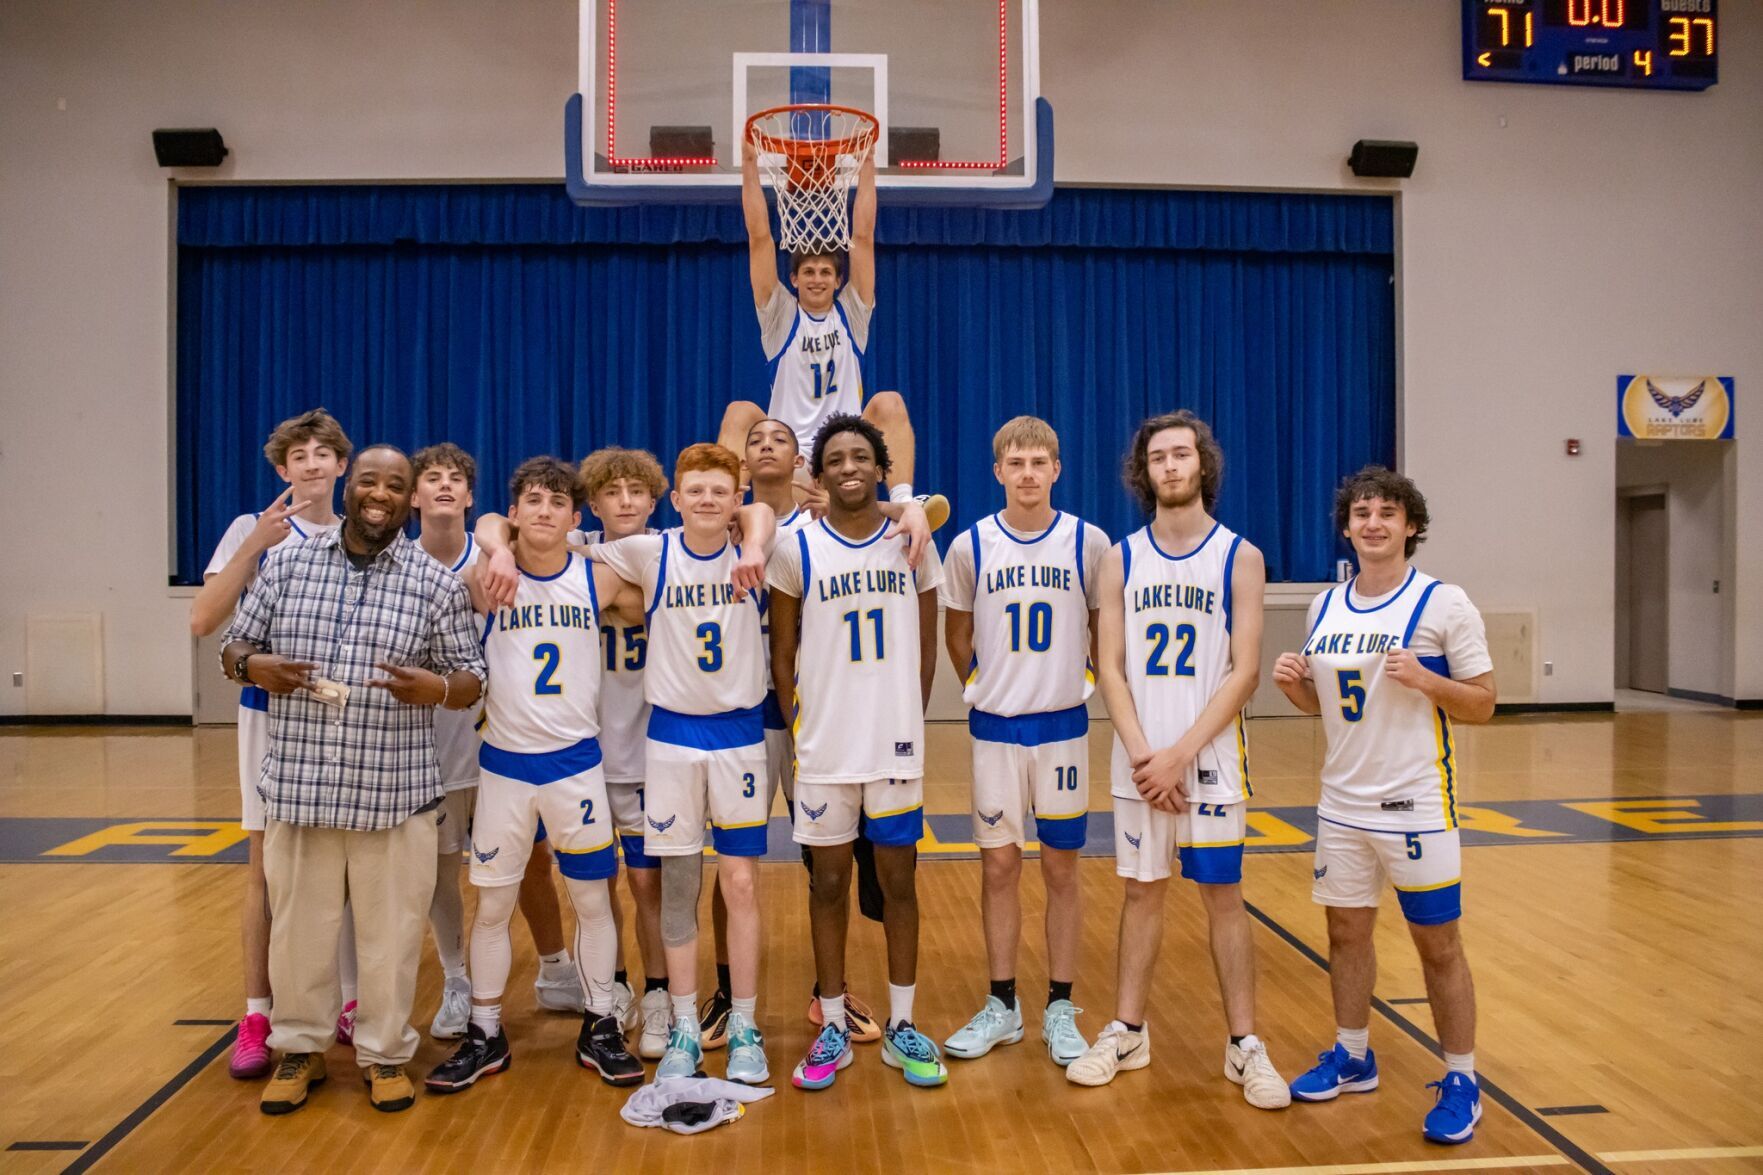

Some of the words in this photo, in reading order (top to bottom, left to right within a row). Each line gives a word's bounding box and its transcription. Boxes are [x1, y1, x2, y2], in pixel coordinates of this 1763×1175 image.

[1487, 8, 1533, 47] 71
[1668, 17, 1713, 56] 37
[1574, 54, 1618, 73] period
[1633, 50, 1652, 76] 4
[810, 359, 838, 399] 12
[666, 584, 706, 608] LAKE
[819, 570, 861, 602] LAKE
[866, 570, 906, 596] LURE
[987, 566, 1025, 595] LAKE
[1031, 565, 1071, 591] LURE
[1134, 584, 1172, 613] LAKE
[1175, 584, 1215, 615] LURE
[500, 605, 543, 632] LAKE
[550, 604, 591, 630] LURE
[1005, 602, 1052, 652] 10
[600, 624, 647, 671] 15
[697, 622, 723, 672] 3
[844, 608, 884, 662] 11
[1146, 623, 1196, 676] 22
[1304, 633, 1354, 656] LAKE
[533, 643, 562, 695] 2
[1337, 670, 1366, 722] 5
[743, 773, 755, 798] 3
[1055, 766, 1078, 790] 10
[580, 800, 595, 825] 2
[1405, 832, 1422, 860] 5
